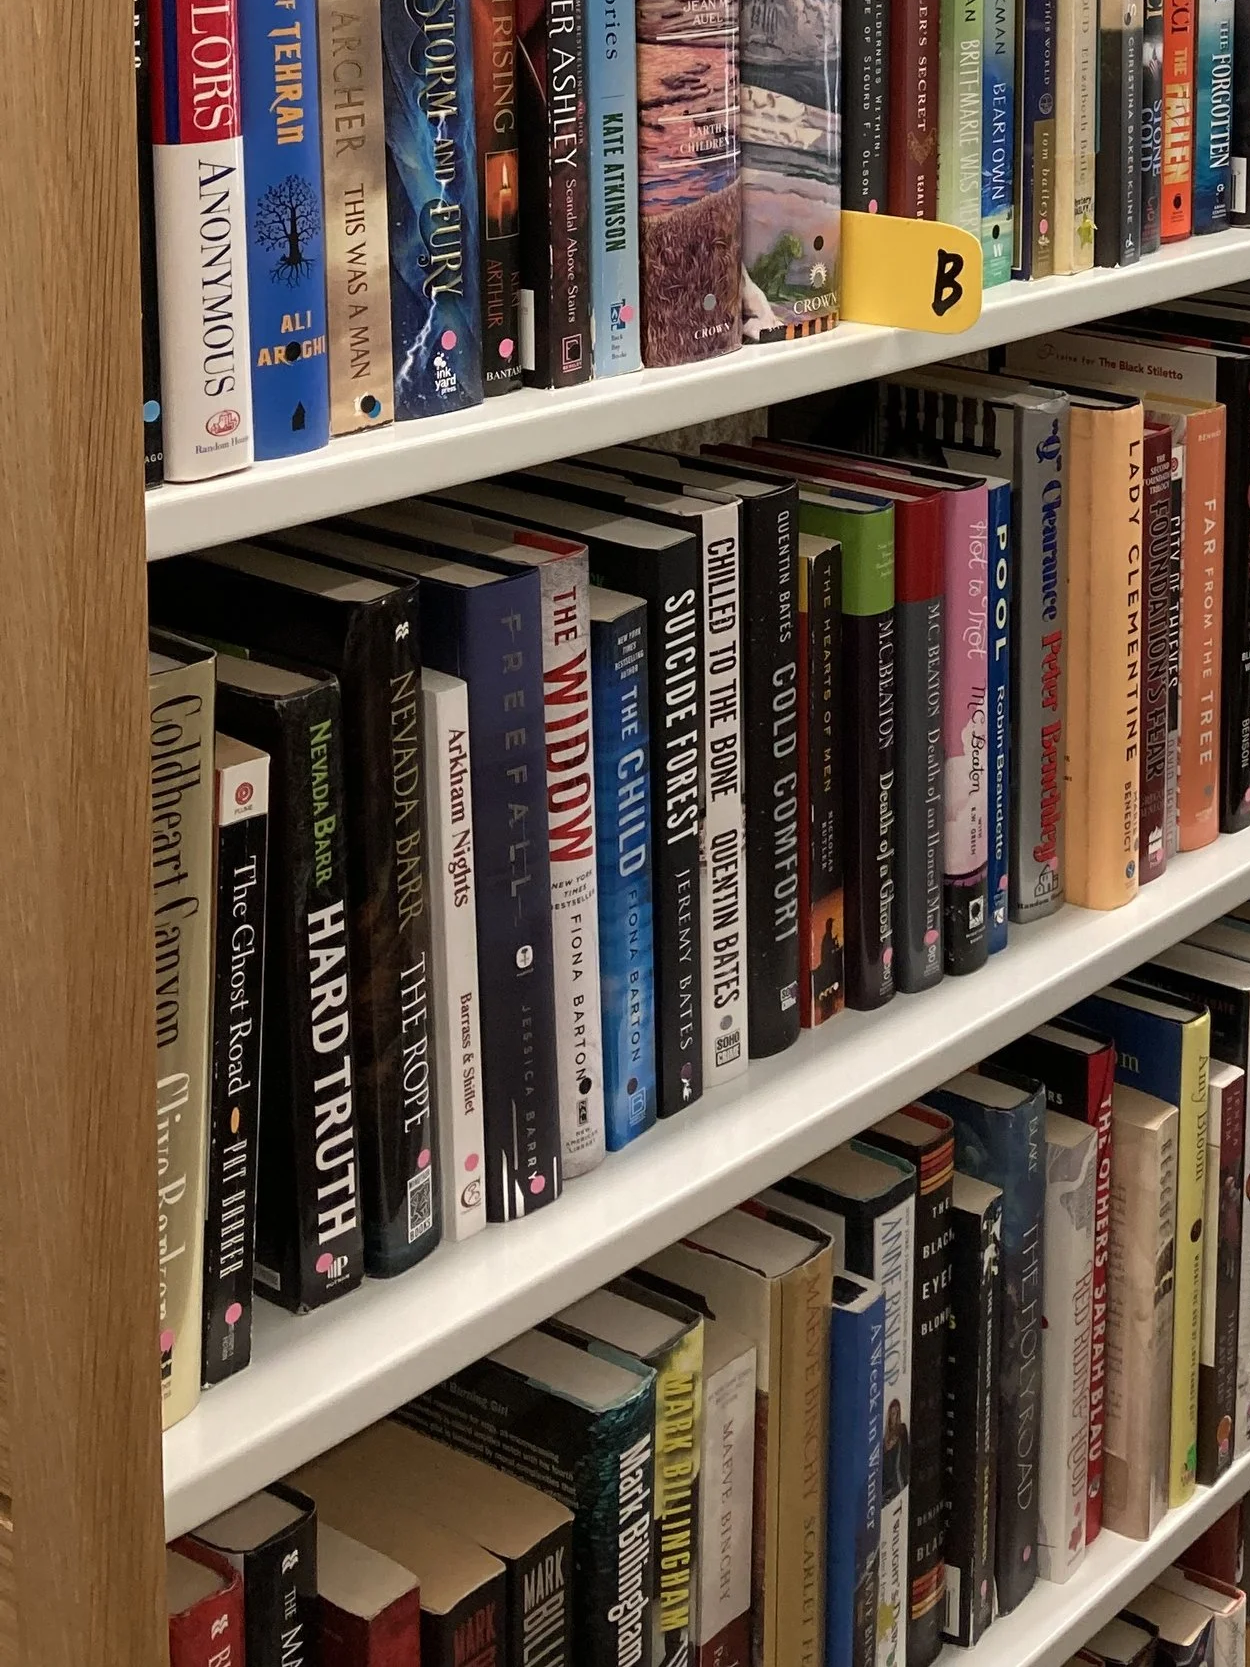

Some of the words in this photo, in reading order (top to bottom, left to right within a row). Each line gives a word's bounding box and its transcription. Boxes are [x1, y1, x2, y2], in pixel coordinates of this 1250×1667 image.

[267, 21, 306, 146] TEHRAN
[330, 9, 368, 158] ARCHER
[551, 46, 579, 169] ASHLEY
[1209, 52, 1232, 169] FORGOTTEN
[602, 111, 625, 158] KATE
[343, 182, 366, 237] THIS
[604, 162, 627, 253] ATKINSON
[197, 160, 236, 398] ANONYMOUS
[345, 243, 368, 297] WAS
[931, 247, 965, 317] B
[280, 310, 312, 334] ALI
[348, 325, 371, 381] MAN
[1127, 439, 1141, 527] LADY
[707, 536, 736, 635] CHILLED
[776, 509, 792, 587] QUENTIN
[993, 523, 1009, 662] POOL
[552, 585, 578, 647] THE
[663, 588, 697, 730] SUICIDE
[1124, 543, 1141, 764] CLEMENTINE
[389, 670, 420, 827] NEVADA
[620, 684, 638, 742] THE
[708, 682, 738, 730] THE
[770, 660, 797, 760] COLD
[1199, 689, 1214, 766] TREE
[308, 717, 333, 817] NEVADA
[447, 727, 468, 826] Arkham
[543, 647, 595, 864] WIDOW
[666, 732, 699, 846] FOREST
[710, 734, 739, 804] BONE
[312, 814, 339, 890] BARR
[617, 746, 647, 879] CHILD
[773, 771, 799, 943] COMFORT
[232, 854, 258, 918] The
[395, 830, 425, 934] BARR
[447, 829, 471, 911] Nights
[674, 868, 692, 964] JEREMY
[710, 827, 740, 932] QUENTIN
[230, 923, 257, 1015] Ghost
[307, 899, 351, 1054] HARD
[399, 950, 429, 1035] THE
[571, 913, 583, 983] FIONA
[712, 933, 741, 1011] BATES
[227, 1020, 254, 1099] Road
[459, 991, 474, 1050] Barrass
[402, 1037, 432, 1135] ROPE
[313, 1055, 358, 1247] TRUTH
[219, 1189, 247, 1282] BARKER
[931, 1197, 951, 1218] THE
[1094, 1156, 1112, 1269] OTHERS
[1090, 1281, 1109, 1384] SARAH
[659, 1373, 696, 1455] MARK
[1087, 1386, 1105, 1464] BLAU
[619, 1433, 652, 1523] Mark
[720, 1419, 736, 1503] MAEVE
[521, 1544, 566, 1608] MARK
[659, 1457, 697, 1633] BILLINGHAM
[718, 1507, 734, 1604] BINCHY
[607, 1516, 652, 1667] Billingham
